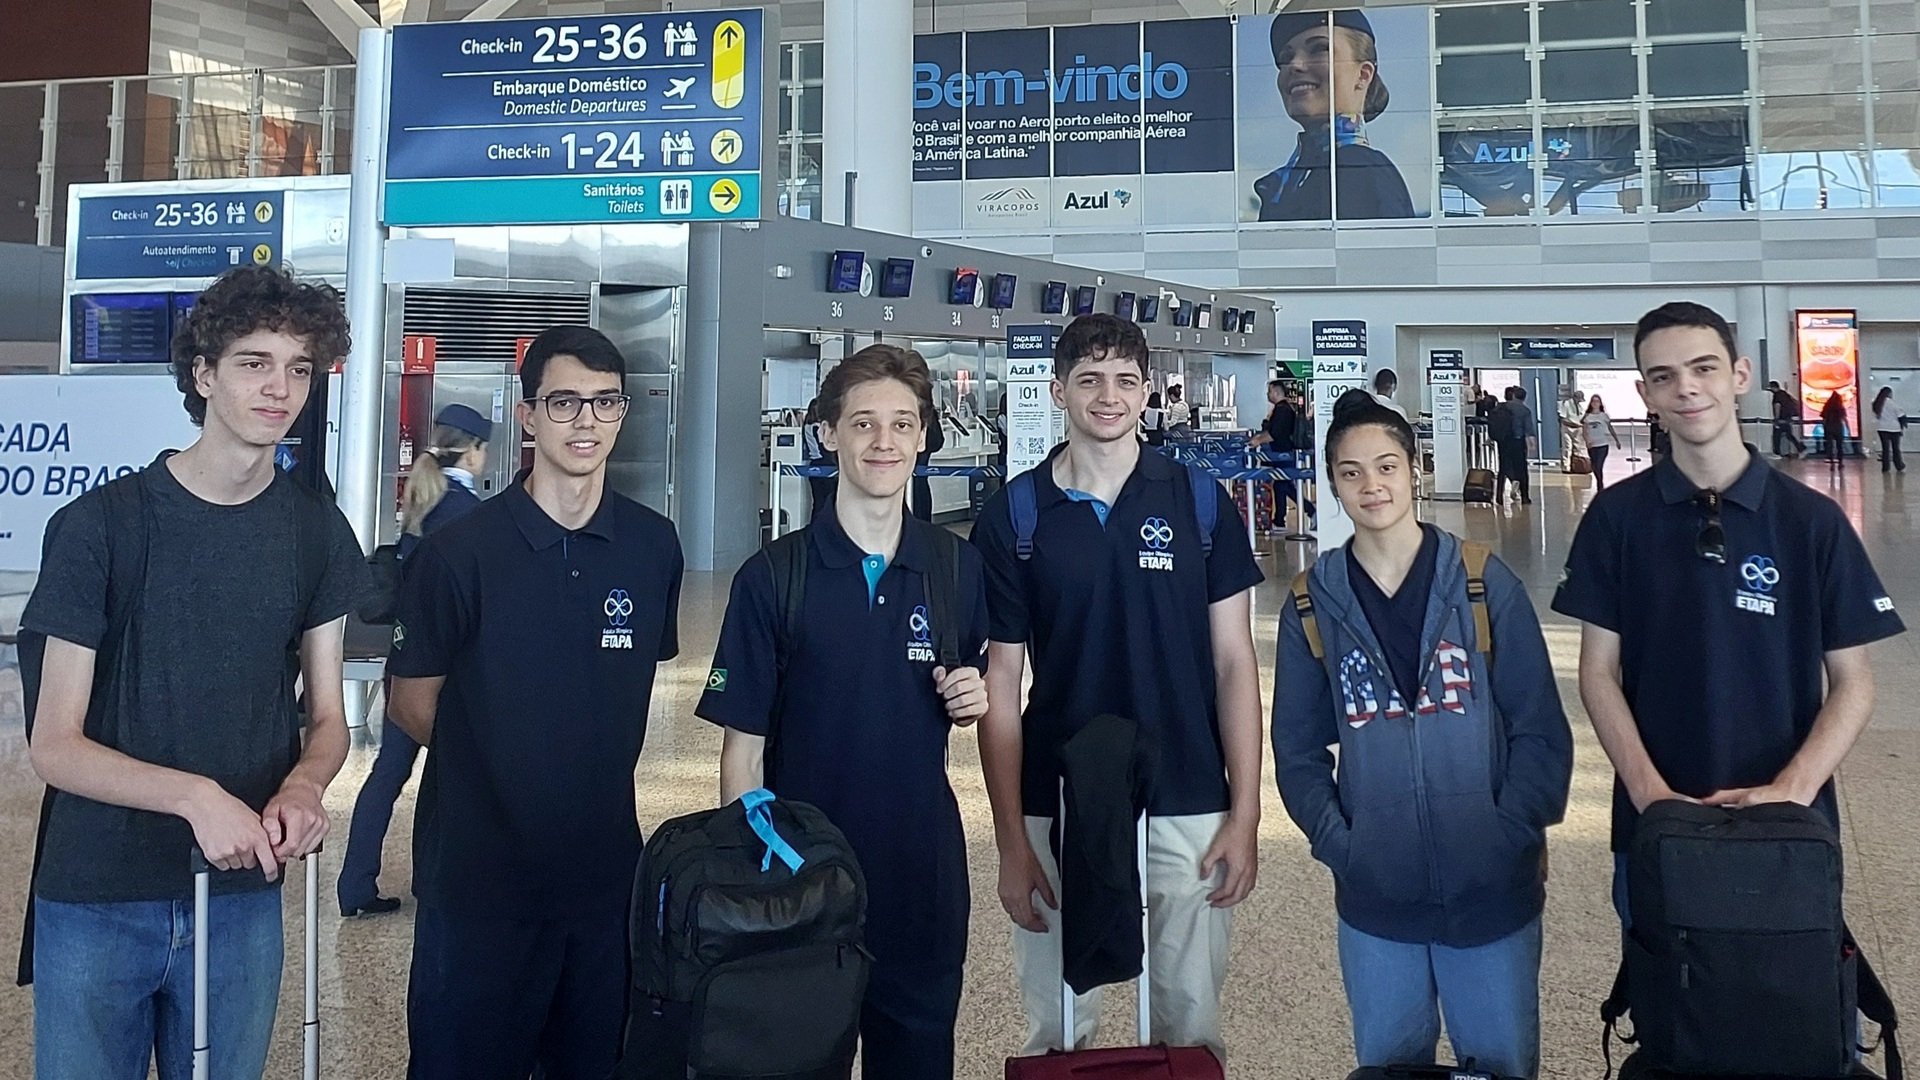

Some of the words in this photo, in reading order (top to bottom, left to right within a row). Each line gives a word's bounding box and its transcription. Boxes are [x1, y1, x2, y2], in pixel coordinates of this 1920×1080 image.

[461, 38, 523, 56] Check-in
[532, 22, 647, 63] 25-36
[493, 80, 565, 97] Embarque
[568, 76, 647, 94] Doméstico
[912, 52, 1189, 110] Bem-vindo
[504, 100, 566, 116] Domestic
[570, 98, 646, 116] Departures
[942, 118, 960, 131] vai
[966, 120, 996, 130] voar
[1000, 118, 1016, 129] no
[1018, 114, 1091, 130] Aeroporto
[1093, 112, 1130, 126] eleito
[1132, 114, 1141, 124] o
[1146, 110, 1193, 123] melhor
[966, 135, 974, 145] e
[977, 134, 1006, 145] com
[1008, 134, 1016, 144] a
[1019, 130, 1068, 143] melhor
[1070, 127, 1141, 143] companhia
[1146, 126, 1186, 138] Aérea
[488, 144, 550, 160] Check-in
[560, 131, 645, 170] 1-24
[925, 148, 981, 161] América
[583, 183, 645, 197] Sanitários
[608, 200, 644, 214] Toilets
[976, 203, 1039, 212] VIRACOPOS
[1064, 192, 1108, 210] Azul
[112, 210, 148, 220] Check-in
[154, 202, 218, 226] 25-36
[142, 245, 216, 256] Autoatendimento
[831, 301, 843, 318] 36
[883, 306, 894, 322] 35
[951, 312, 962, 327] 34
[991, 315, 1000, 329] 33
[1010, 364, 1035, 375] Azul
[1316, 362, 1344, 372] Azul
[1023, 386, 1038, 399] 01
[0, 422, 70, 452] ADA
[43, 466, 146, 496] BRA
[1139, 557, 1173, 571] ETAPA
[1736, 596, 1775, 616] ETAPA
[601, 635, 632, 648] ETAPA
